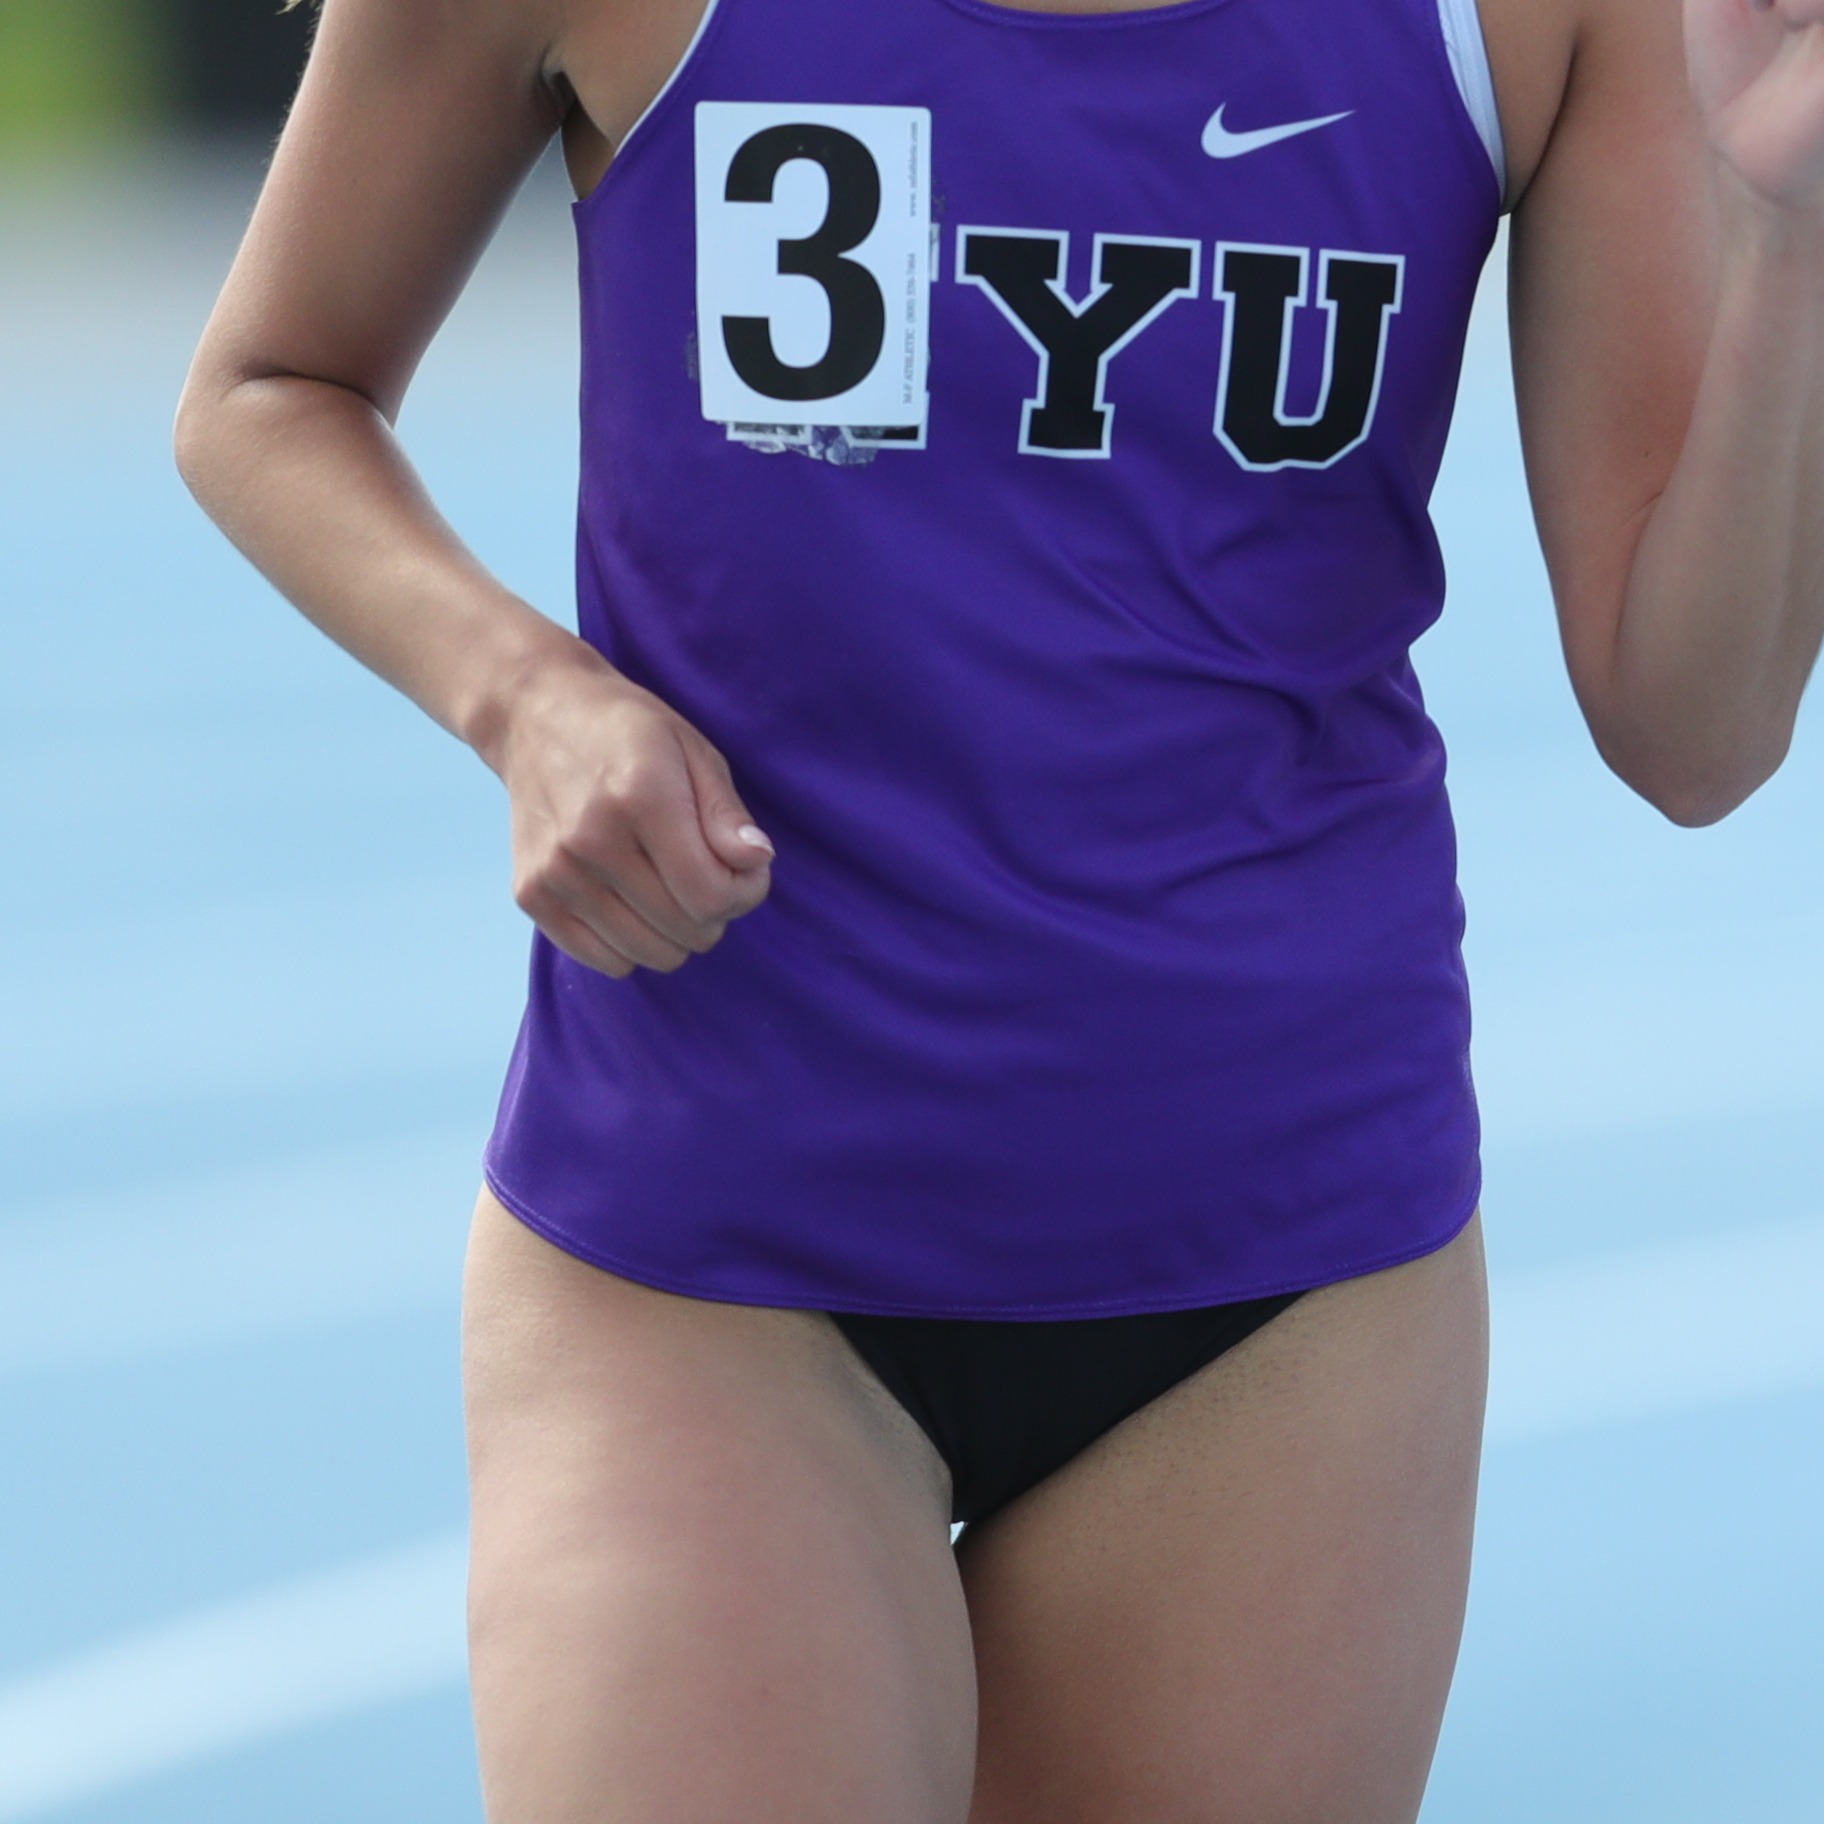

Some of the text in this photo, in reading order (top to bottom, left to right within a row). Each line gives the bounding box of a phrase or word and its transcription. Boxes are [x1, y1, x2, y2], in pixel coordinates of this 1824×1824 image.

[721, 122, 886, 402] 3
[727, 223, 1405, 473] YU
[903, 328, 915, 382] ATHLETIC
